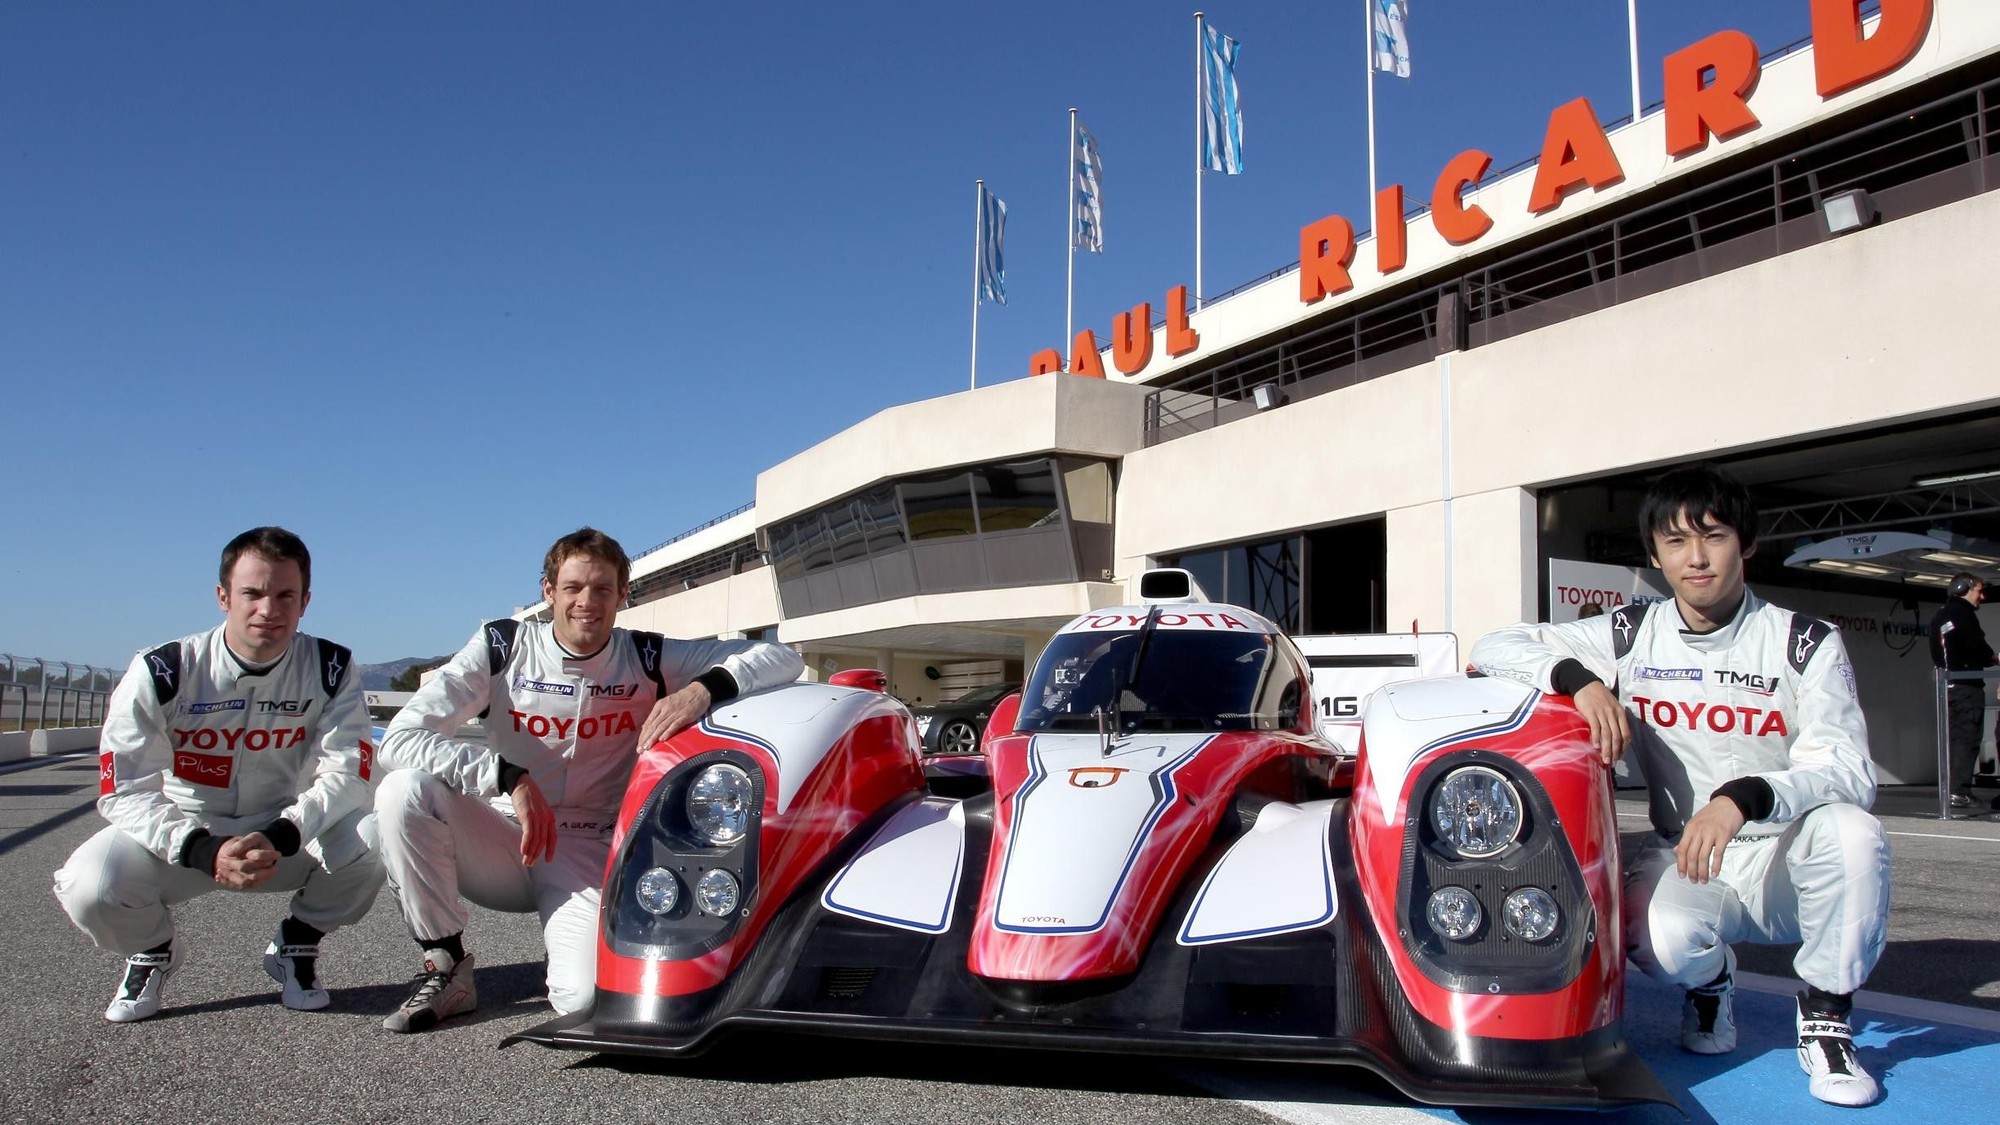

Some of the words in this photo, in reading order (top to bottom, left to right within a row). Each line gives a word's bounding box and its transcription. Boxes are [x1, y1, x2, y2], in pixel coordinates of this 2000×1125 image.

[1301, 0, 1933, 302] RICARD
[1557, 586, 1624, 607] TOYOTA
[1072, 613, 1250, 630] TOYOTA
[1646, 669, 1701, 678] MICHELIN
[1714, 670, 1765, 688] TMG
[525, 681, 572, 693] MICHELIN
[586, 685, 624, 697] TMG
[191, 700, 243, 712] MICHELIN
[257, 700, 298, 712] TMG
[508, 709, 636, 740] TOYOTA
[1632, 696, 1788, 737] TOYOTA
[174, 726, 306, 751] TOYOTA
[178, 755, 228, 777] Plus
[1021, 916, 1066, 925] TOYOTA
